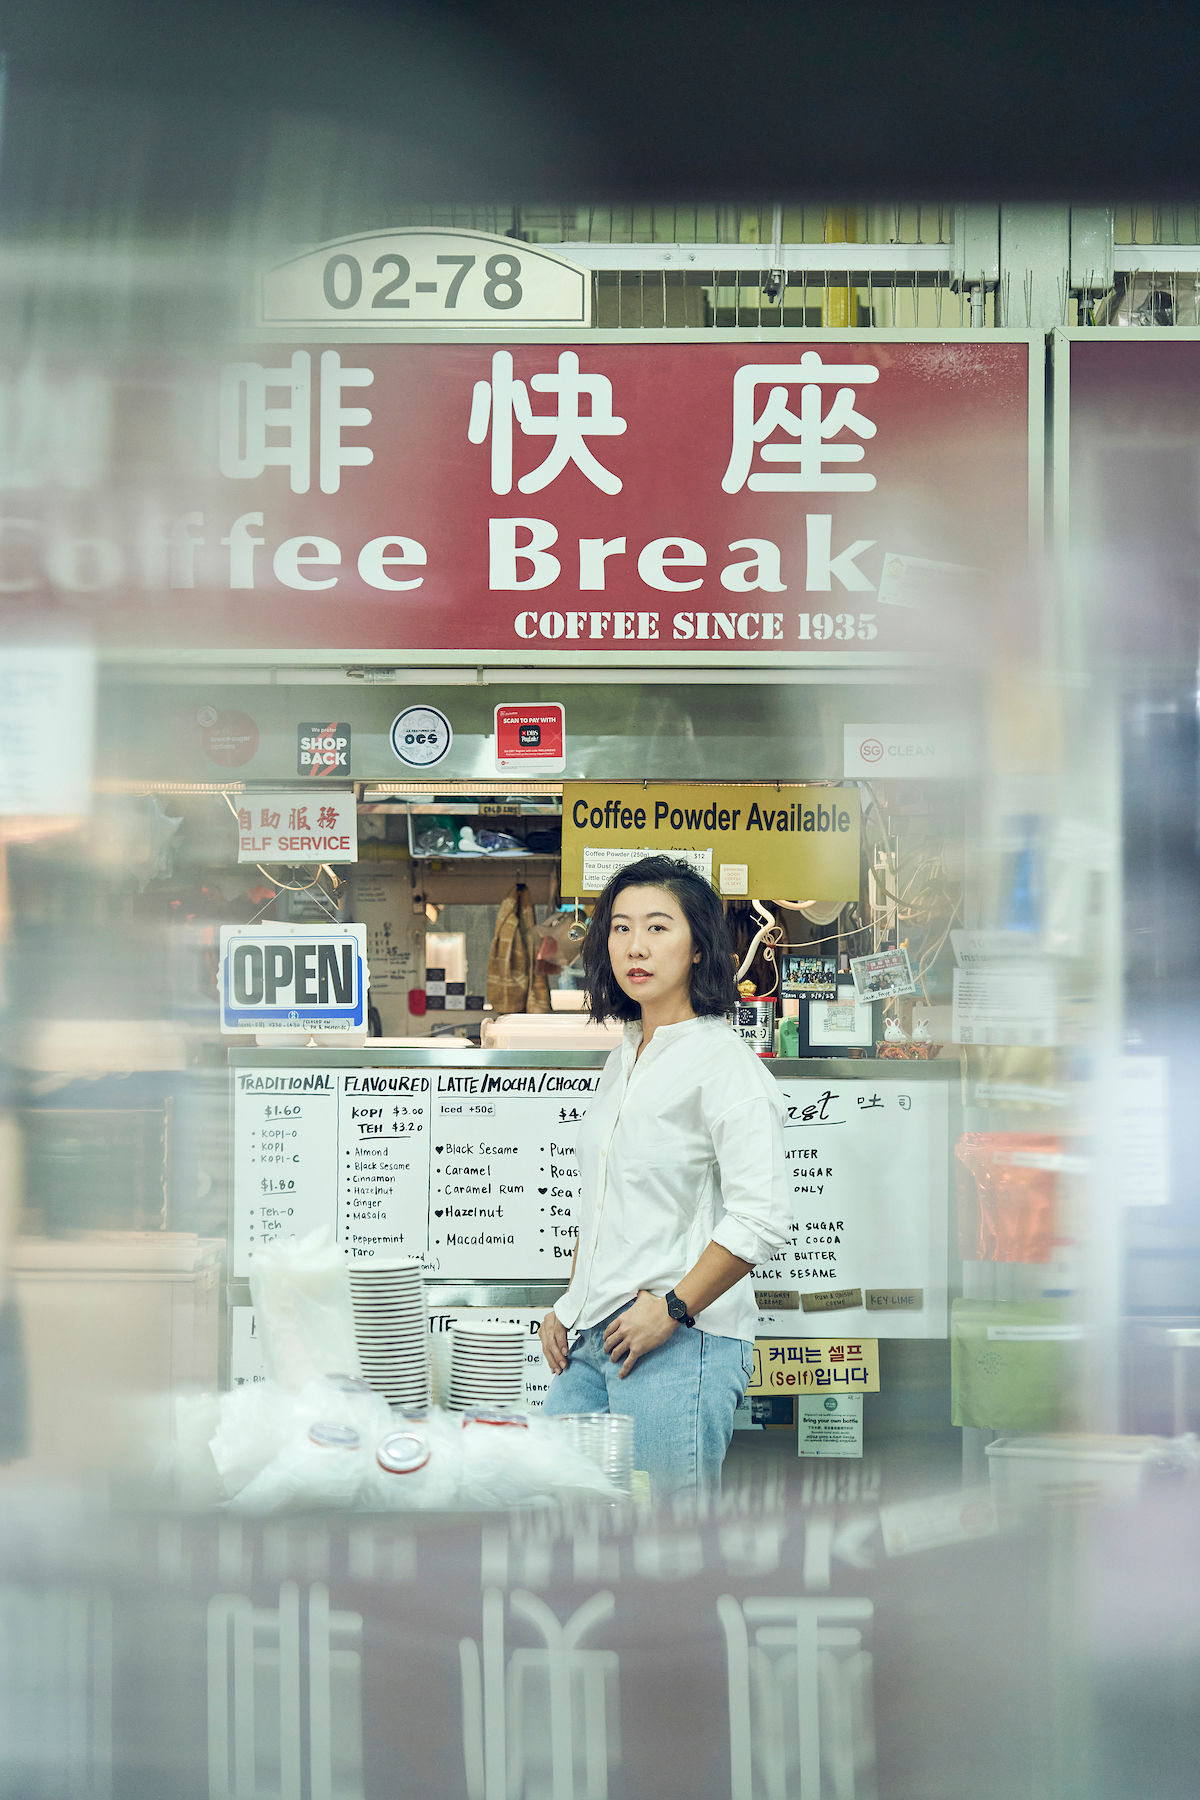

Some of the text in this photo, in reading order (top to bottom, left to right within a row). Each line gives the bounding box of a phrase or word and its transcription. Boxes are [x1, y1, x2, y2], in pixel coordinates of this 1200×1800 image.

[323, 254, 523, 310] 02-78
[220, 350, 879, 495] 啡快座
[488, 513, 880, 593] Break
[514, 611, 878, 641] COFFEE SINCE 1935
[300, 737, 347, 750] SHOP
[863, 745, 936, 756] SG CLEAN
[300, 752, 347, 765] BACK
[573, 800, 850, 832] Coffee Powder Available
[241, 836, 350, 851] ELF SERVICE
[234, 945, 353, 1005] OPEN
[740, 1028, 757, 1038] JAR
[238, 1074, 335, 1090] TRADITIONAL
[344, 1076, 430, 1092] FLAVOURED
[265, 1105, 301, 1118] $1.60
[352, 1105, 424, 1119] KOPI $3.00
[440, 1105, 463, 1113] Iced
[559, 1108, 586, 1120] $4.
[358, 1122, 423, 1134] TEH $3.20
[261, 1143, 284, 1152] KOPI
[355, 1147, 389, 1156] Almond
[446, 1142, 518, 1154] Black Sesame
[550, 1142, 576, 1157] Pum
[261, 1154, 301, 1164] KOPI-C
[785, 1149, 818, 1159] UTTER
[354, 1162, 411, 1171] Black Sesame
[445, 1165, 491, 1176] Caramel
[793, 1168, 833, 1177] SUGAR
[260, 1177, 295, 1192] $1.80
[352, 1175, 396, 1183] Cinnamon
[354, 1186, 394, 1195] Hazelnut
[445, 1183, 491, 1194] Caramel
[550, 1186, 573, 1198] Sea
[794, 1185, 824, 1194] ONLY
[353, 1199, 382, 1208] Ginger
[353, 1212, 387, 1220] Masala
[445, 1205, 504, 1217] Hazelnut
[550, 1205, 571, 1216] Sea
[261, 1220, 282, 1230] Teh
[805, 1221, 844, 1232] SUGAR
[551, 1226, 579, 1237] Toff
[353, 1233, 404, 1244] Peppermint
[446, 1232, 515, 1246] Macadamia
[805, 1236, 841, 1244] COCOA
[351, 1247, 375, 1257] Taro
[794, 1251, 837, 1261] BUTTER
[750, 1268, 837, 1279] BLACK SESAME
[870, 1295, 888, 1305] KEY
[892, 1295, 915, 1305] LIME
[769, 1345, 863, 1364] 커피는 셀프
[526, 1382, 550, 1391] Hone
